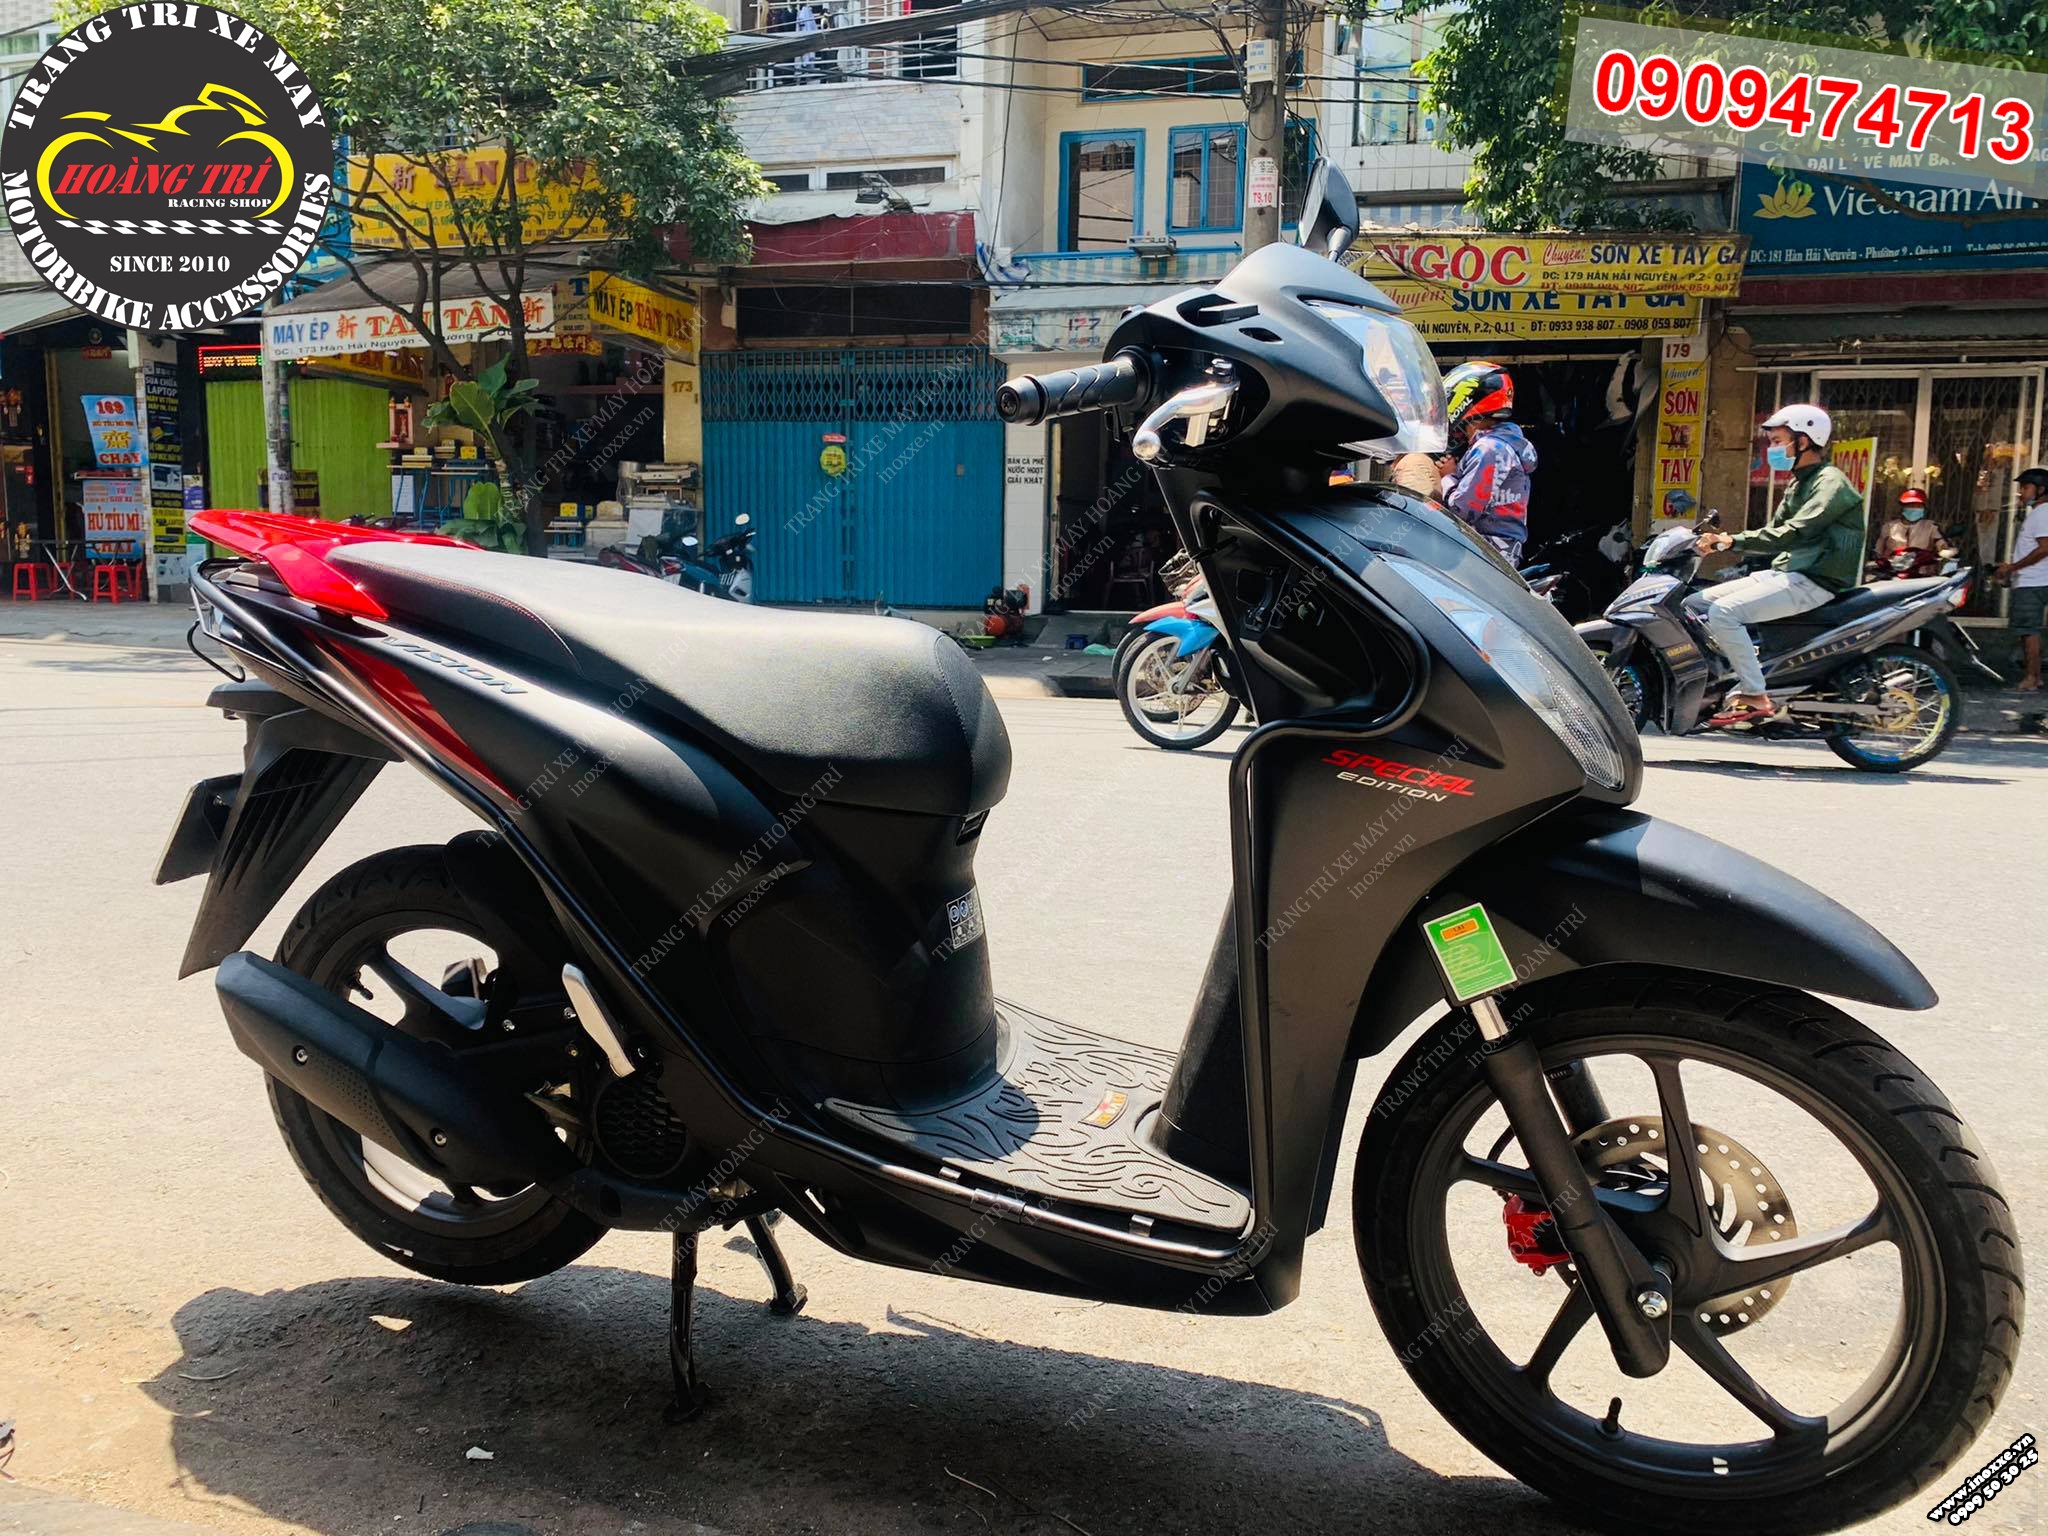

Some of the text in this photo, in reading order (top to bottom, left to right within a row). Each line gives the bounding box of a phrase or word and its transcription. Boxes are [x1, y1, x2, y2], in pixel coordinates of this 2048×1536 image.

[1823, 185, 1972, 216] Vietnam
[1637, 245, 1662, 265] XE
[1717, 245, 1744, 265] GA
[1564, 271, 1583, 281] 179
[1634, 270, 1678, 282] NGUYÊN
[273, 317, 330, 345] MÁY ÉP
[1549, 320, 1572, 332] 0933
[1576, 319, 1594, 331] 938
[1596, 319, 1614, 331] 807
[1624, 318, 1648, 330] 0908
[1651, 318, 1669, 330] 059
[1672, 318, 1691, 330] 807
[1666, 343, 1690, 358] 179
[147, 386, 178, 397] LAPTOP
[672, 381, 693, 393] 173
[1450, 396, 1473, 424] ROYAL
[1664, 387, 1700, 416] SƠN
[99, 453, 142, 465] CHAY
[1661, 458, 1695, 485] TAY
[1321, 748, 1475, 796] SPECIAL
[1336, 771, 1447, 802] EDITION
